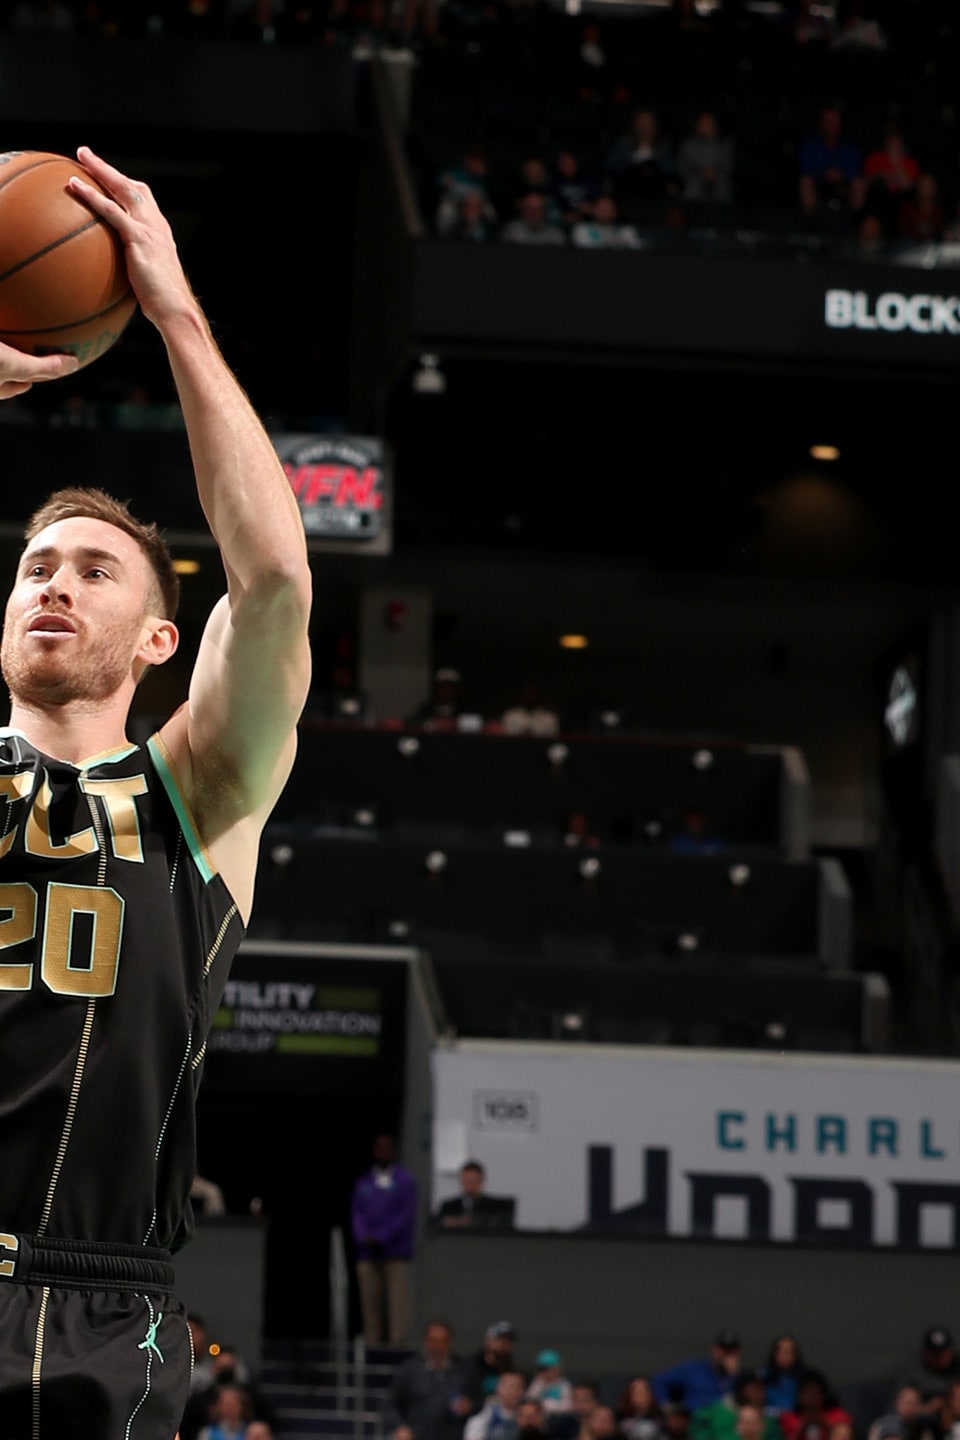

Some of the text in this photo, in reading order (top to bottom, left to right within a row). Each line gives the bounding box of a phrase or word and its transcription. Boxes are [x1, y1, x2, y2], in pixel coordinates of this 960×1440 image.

[825, 289, 960, 335] BLOCK
[224, 981, 315, 1008] TILITY
[717, 1110, 960, 1160] CHARL
